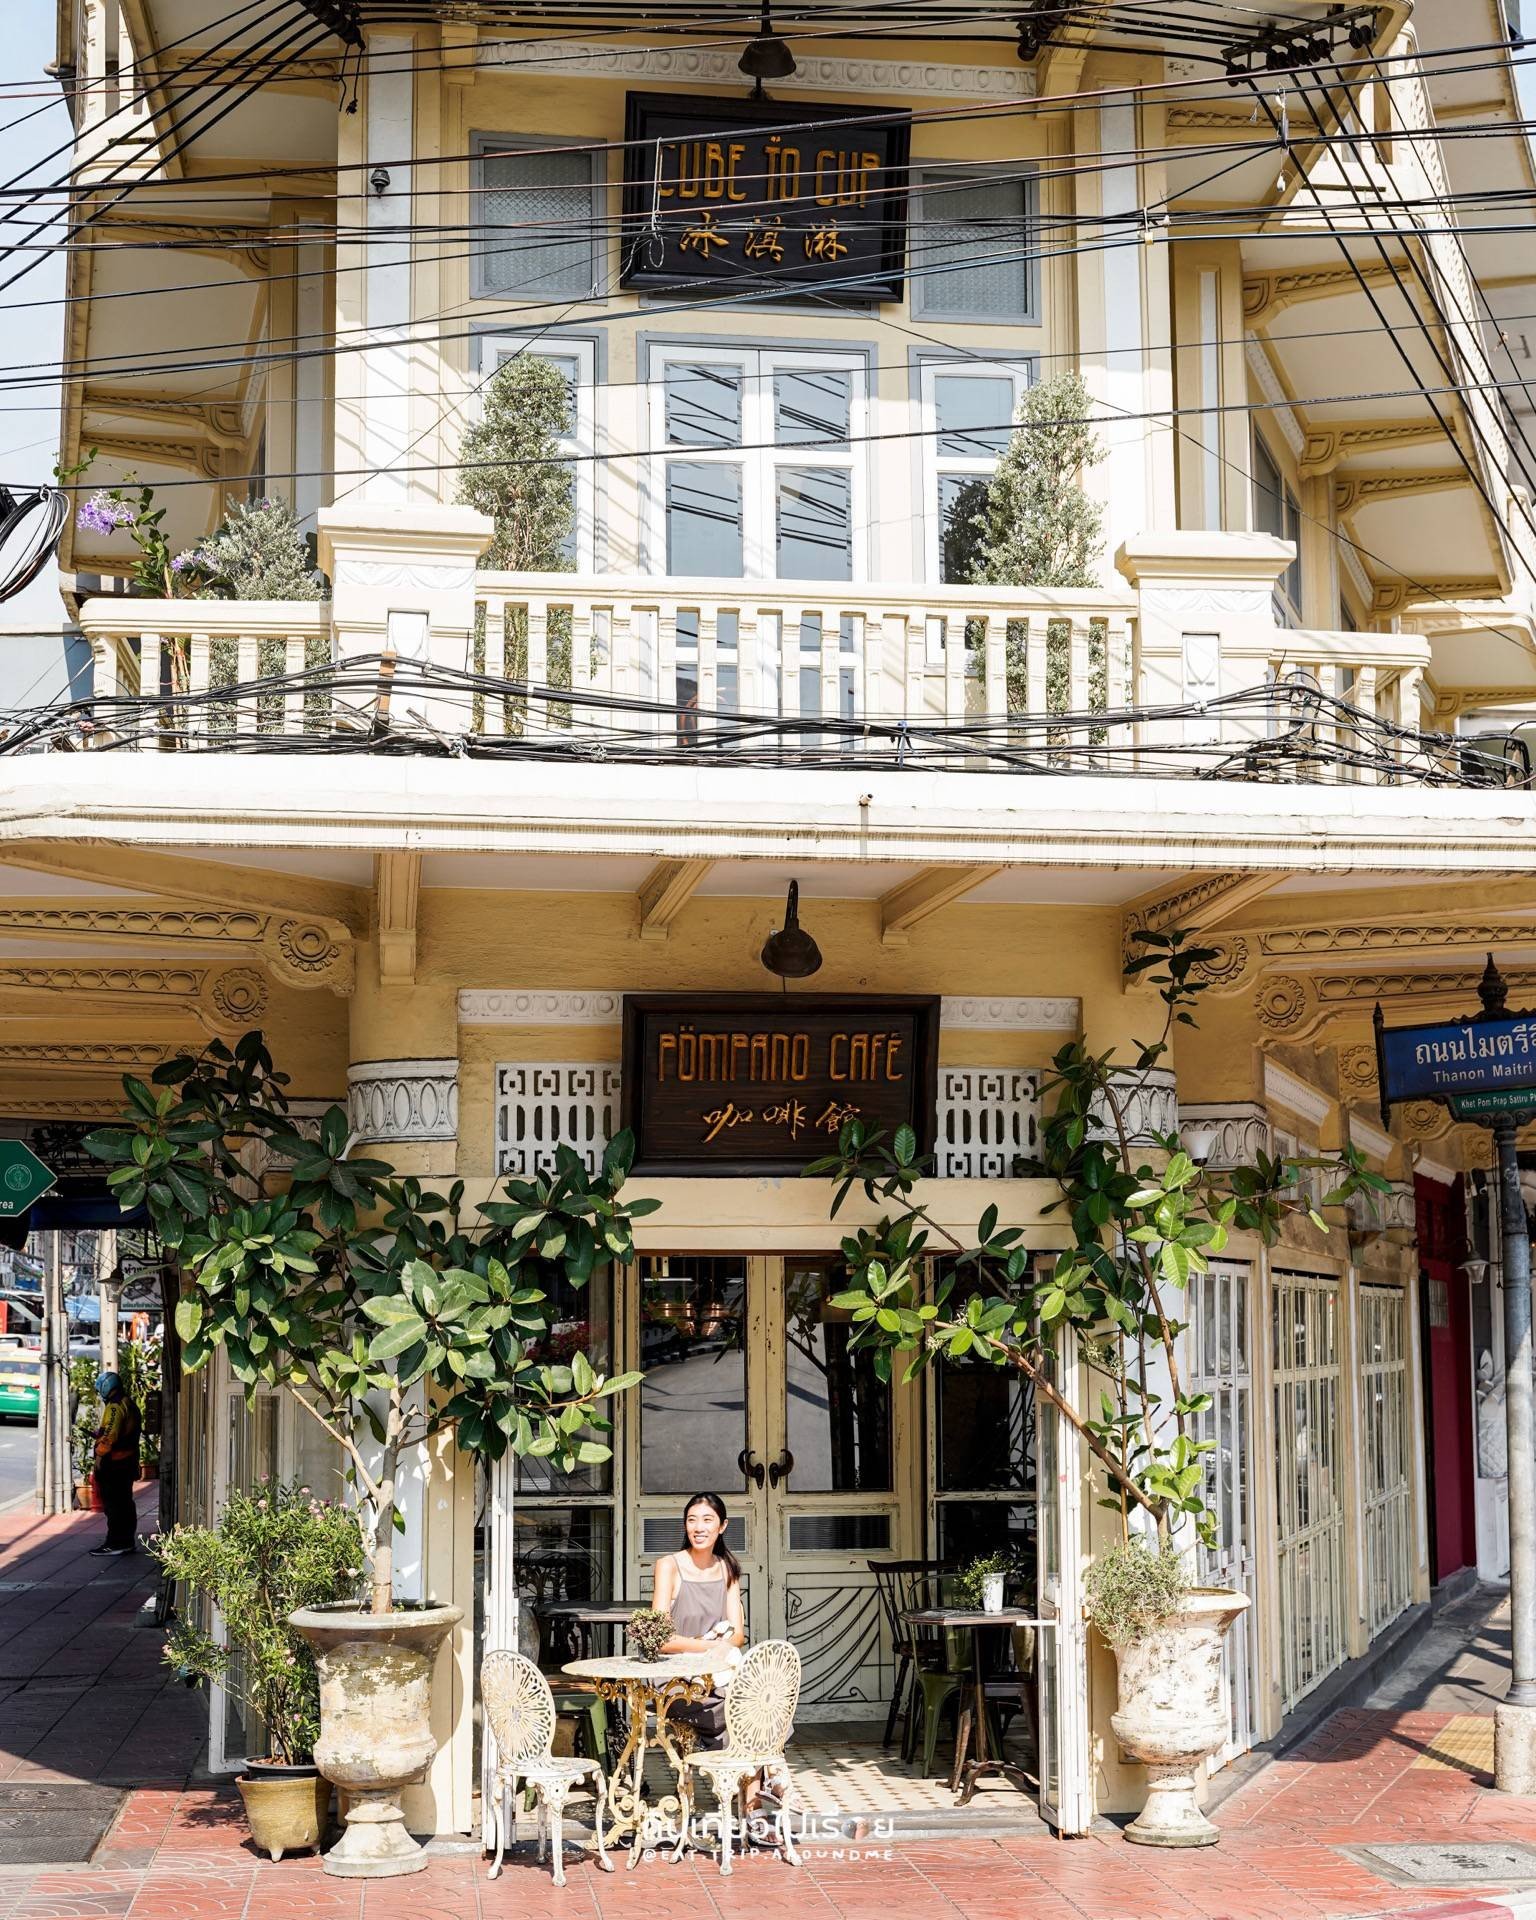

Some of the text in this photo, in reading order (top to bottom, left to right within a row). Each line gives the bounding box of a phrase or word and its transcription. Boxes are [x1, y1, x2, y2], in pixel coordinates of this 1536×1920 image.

[815, 150, 881, 209] CUP
[1433, 1062, 1533, 1084] Thanon Maitri
[1461, 1098, 1475, 1109] Khet
[1478, 1098, 1491, 1107] Pom
[1493, 1096, 1507, 1107] Prap
